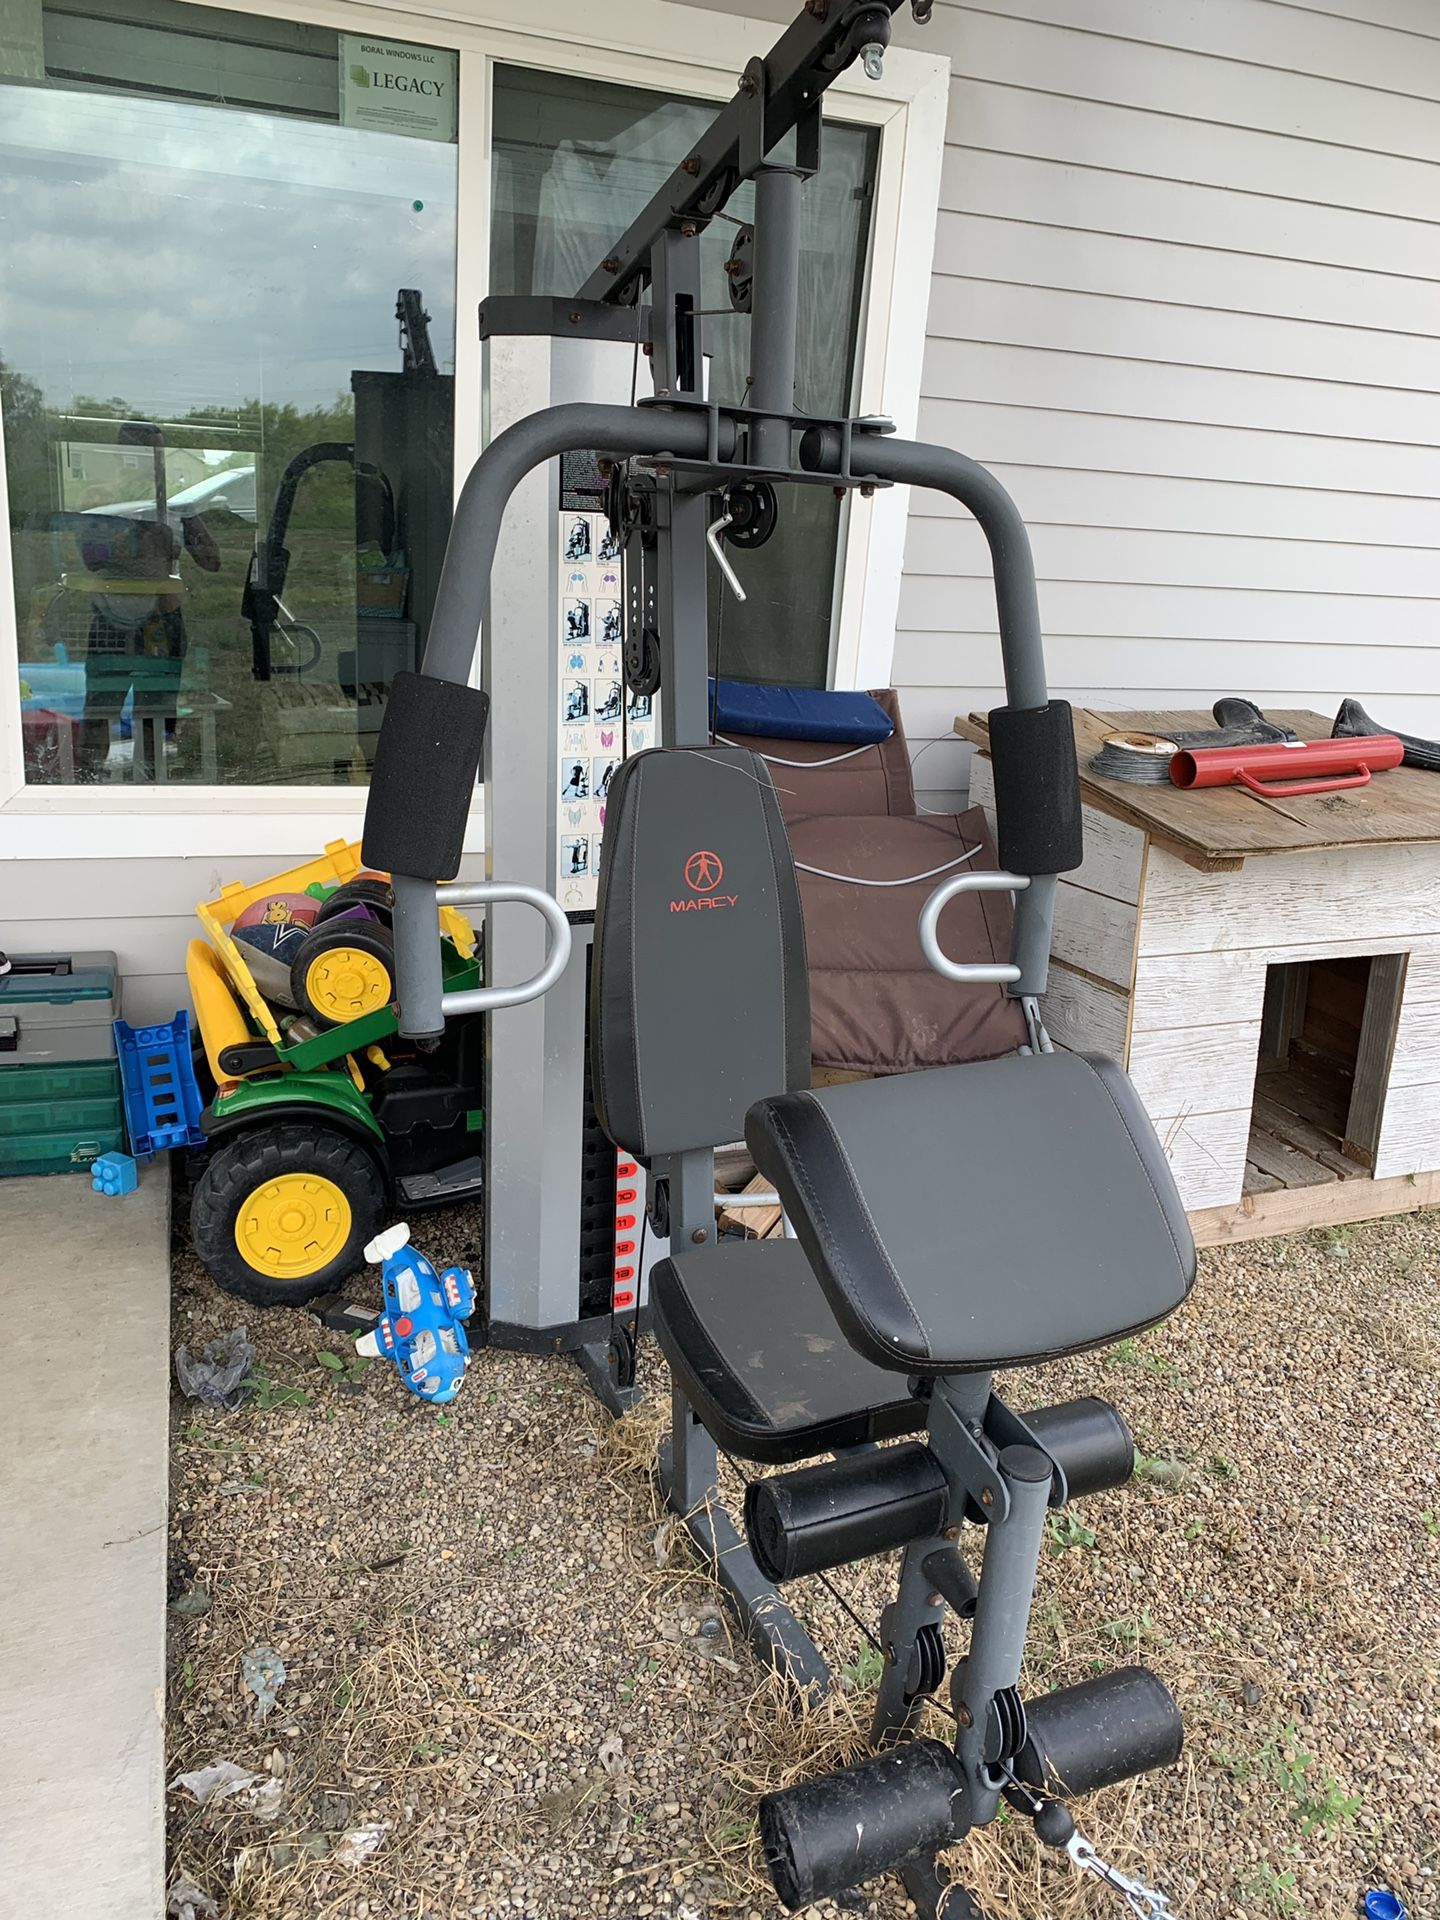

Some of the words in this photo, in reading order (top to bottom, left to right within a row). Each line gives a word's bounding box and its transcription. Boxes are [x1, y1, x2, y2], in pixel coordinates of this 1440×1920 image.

[361, 45, 384, 55] BORAL
[386, 48, 421, 61] WINDOWS
[373, 72, 445, 97] LEGACY
[670, 895, 739, 912] MARCY
[618, 1167, 629, 1175] 9
[618, 1192, 632, 1200] 10
[617, 1219, 627, 1227] 11
[616, 1245, 629, 1253] 12
[615, 1295, 630, 1303] 14
